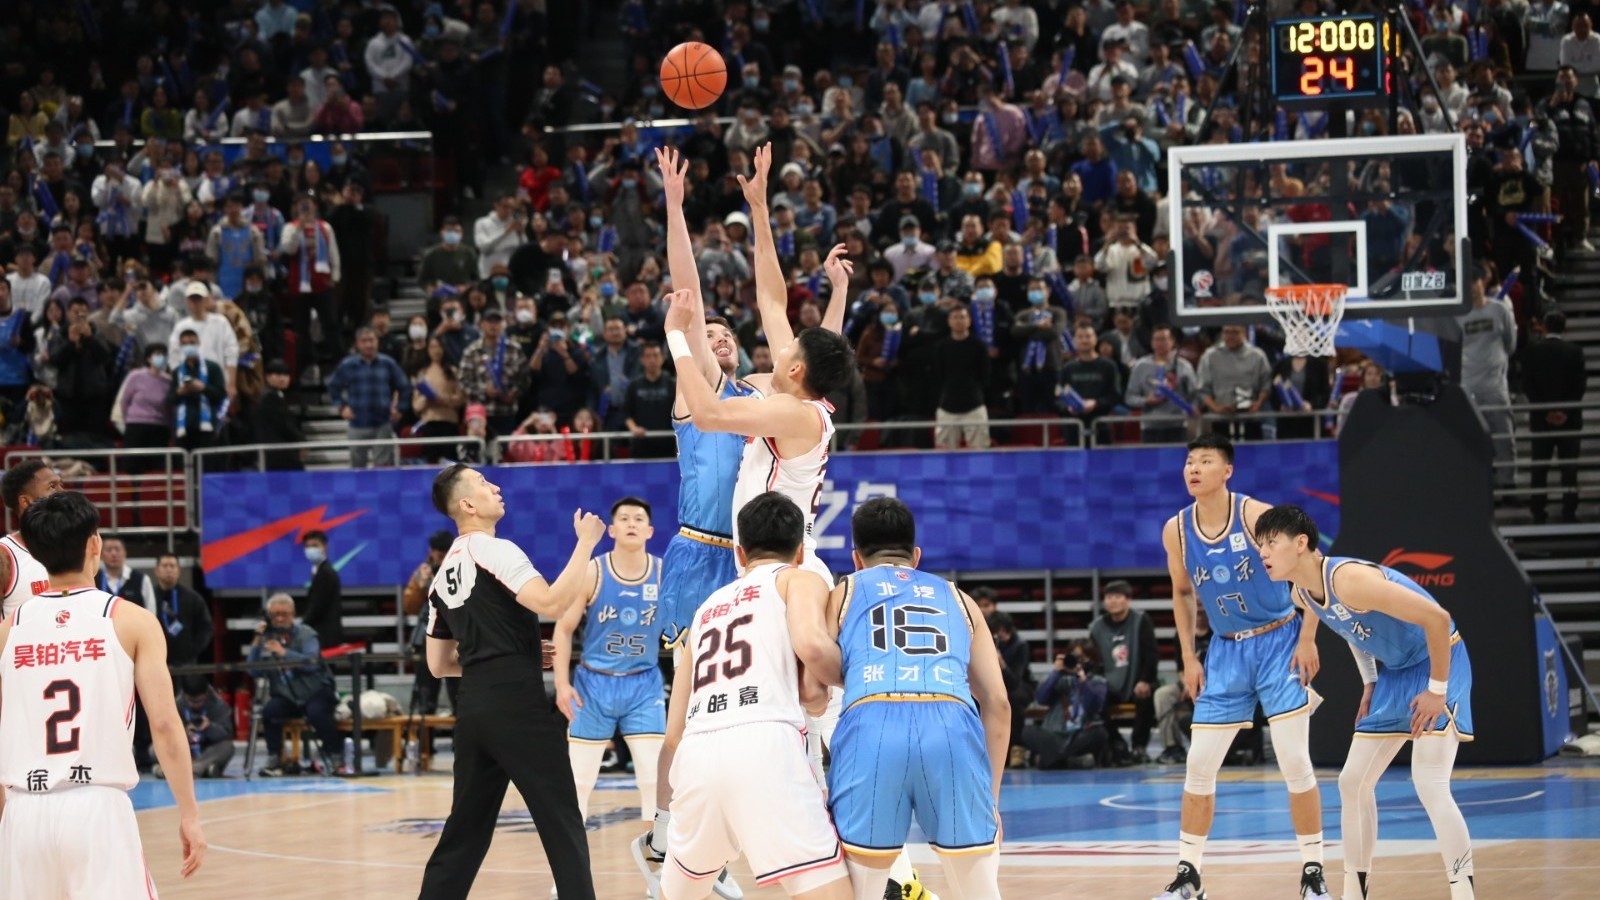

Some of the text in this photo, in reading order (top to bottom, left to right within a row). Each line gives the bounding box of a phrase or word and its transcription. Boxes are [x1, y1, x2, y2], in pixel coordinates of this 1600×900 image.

[1301, 56, 1354, 95] 24
[876, 581, 936, 599] 北汽
[598, 603, 658, 627] 北京
[1215, 592, 1249, 617] 17
[869, 602, 948, 656] 16
[13, 638, 107, 669] 昊铂汽车
[606, 632, 648, 657] 25
[693, 613, 754, 694] 25
[863, 664, 955, 685] 张才仁
[43, 679, 81, 755] 2
[26, 765, 93, 791] 徐杰
